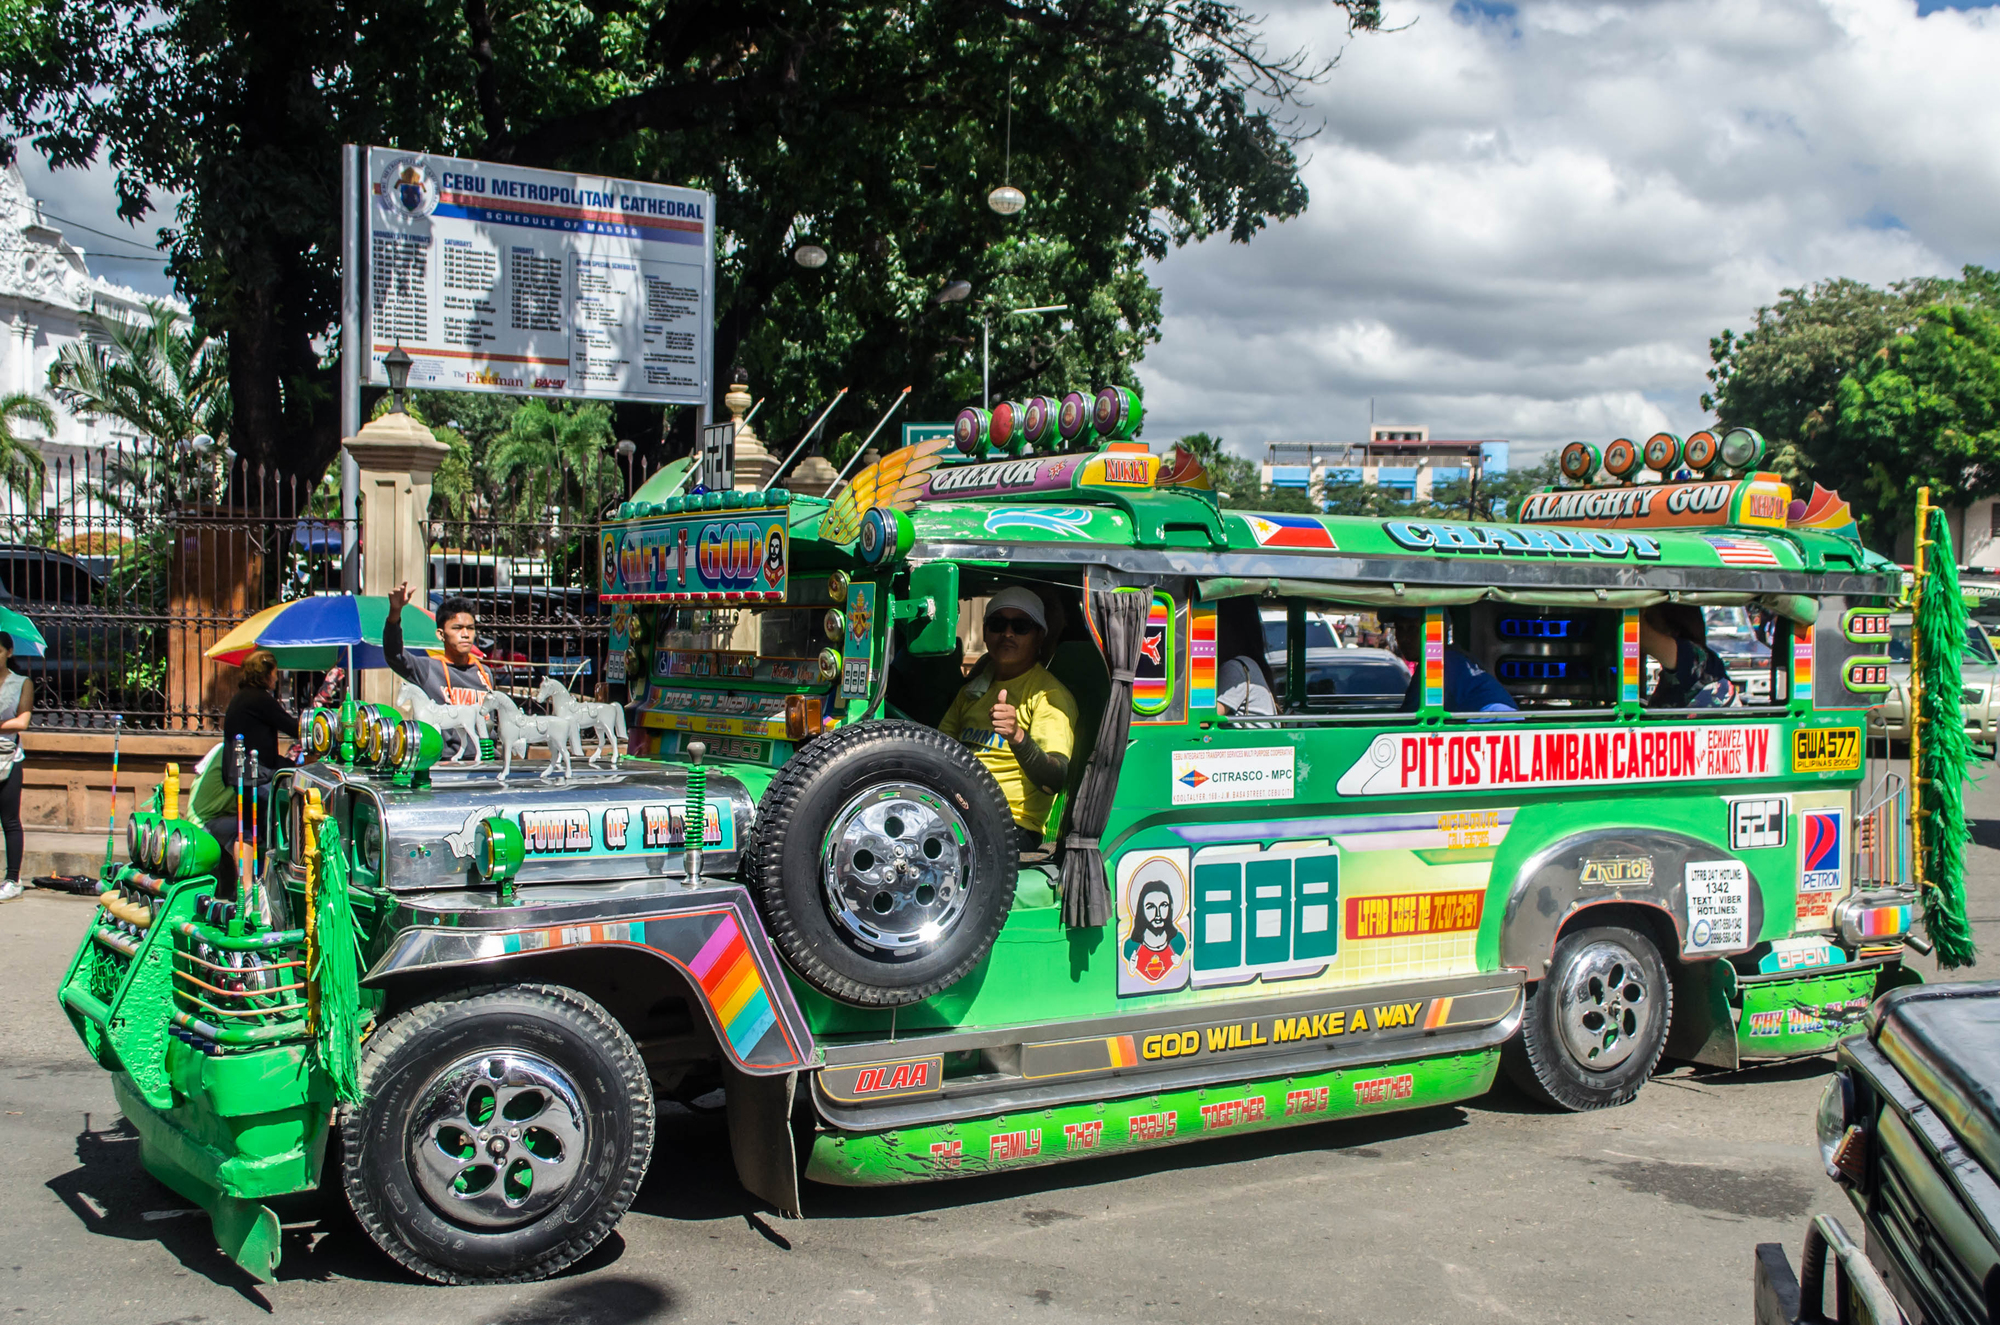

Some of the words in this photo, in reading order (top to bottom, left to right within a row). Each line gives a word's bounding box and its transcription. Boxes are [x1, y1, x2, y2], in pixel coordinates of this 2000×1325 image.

[442, 172, 485, 194] CEBU
[491, 178, 615, 209] METROPOLITAN
[620, 194, 704, 220] CATHEDRAL
[486, 211, 556, 228] SCHEDULE
[564, 221, 580, 230] OF
[587, 222, 638, 235] MASSES
[452, 370, 465, 378] The
[465, 372, 524, 386] Freeman
[929, 459, 1045, 493] CREATOR
[1104, 458, 1149, 484] NIKKI
[1521, 486, 1662, 523] ALMIGHTY
[1667, 483, 1731, 514] GOD
[1383, 521, 1661, 560] CHARIOT
[620, 528, 671, 588] GIFT
[697, 522, 763, 584] GOD
[1486, 732, 1609, 784] TALAMBAN
[1612, 730, 1696, 779] CARBON
[1707, 749, 1742, 775] RAMOS
[1798, 759, 1832, 768] PILIPINAS
[1834, 758, 1851, 767] 2000
[1212, 771, 1263, 783] CITRASCO
[1272, 769, 1292, 779] MPC
[519, 808, 593, 853] POWER
[1738, 800, 1783, 847] 62C
[1580, 860, 1652, 884] Chariot
[1692, 870, 1706, 881] LTFRB
[1803, 871, 1839, 888] PETRON
[1692, 896, 1712, 905] TEXT
[1719, 896, 1742, 904] VIBER
[1706, 882, 1729, 894] 1342
[1193, 854, 1339, 972] 888
[1357, 898, 1389, 937] LTFRB
[1391, 896, 1416, 934] CASE
[1697, 906, 1738, 915] HOTLINES:
[1777, 946, 1830, 969] OPON
[1142, 1030, 1200, 1061] GOD
[1206, 1022, 1267, 1052] WILL
[1273, 1011, 1345, 1044] MAKE
[1349, 1009, 1369, 1034] A
[1373, 1002, 1423, 1030] WAY
[1749, 1010, 1785, 1037] THY
[852, 1062, 929, 1095] DLAA
[1353, 1073, 1413, 1107] TOGETHER
